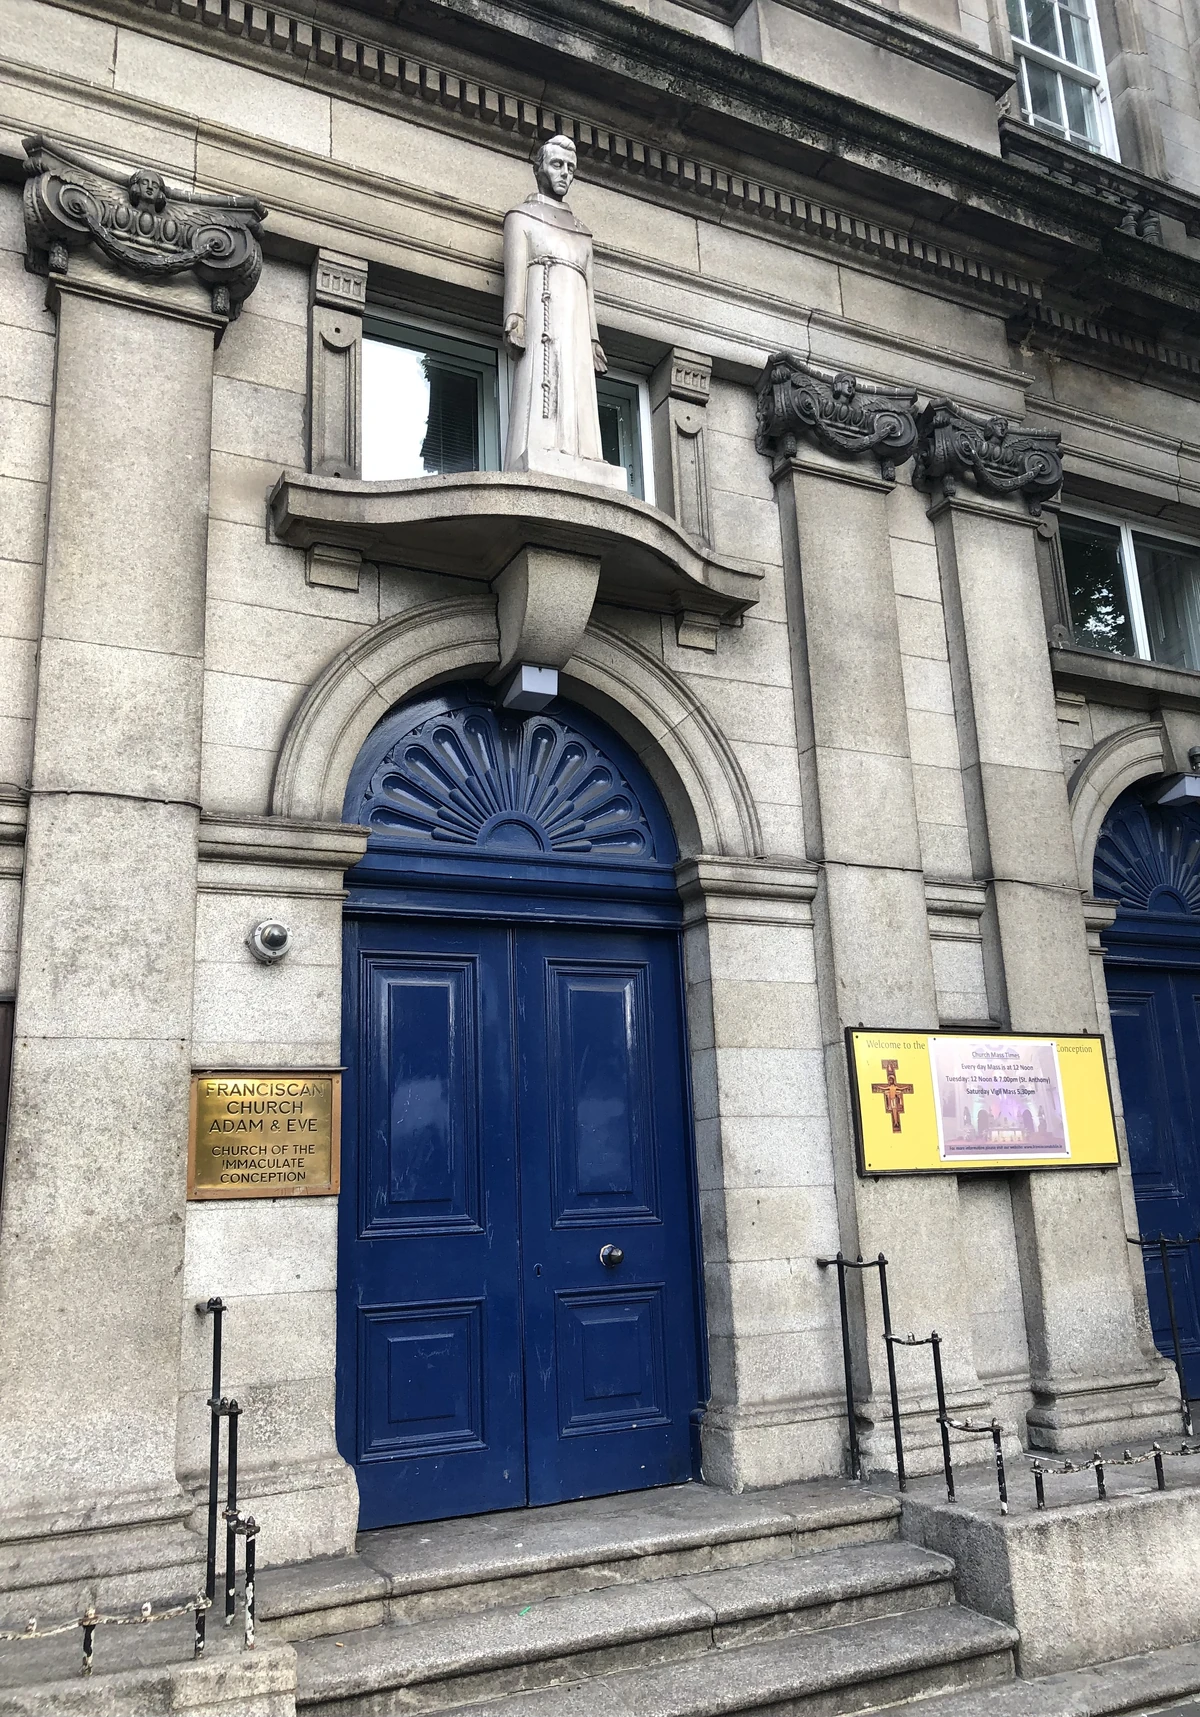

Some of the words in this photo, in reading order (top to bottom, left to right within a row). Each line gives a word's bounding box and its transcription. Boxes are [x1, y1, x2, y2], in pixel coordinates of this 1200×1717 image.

[866, 1039, 901, 1049] Welcome
[913, 1041, 926, 1050] the
[1056, 1044, 1093, 1054] Conception
[977, 1063, 986, 1071] day
[1028, 1076, 1051, 1084] Anthony)
[206, 1083, 325, 1097] FRANCISCAN
[991, 1088, 1002, 1096] Vigil
[226, 1101, 303, 1115] CHURCH
[208, 1119, 263, 1133] ADAM
[270, 1119, 281, 1132] &
[287, 1118, 318, 1132] EVE
[211, 1145, 267, 1156] CHURCH
[271, 1145, 289, 1155] OF
[293, 1144, 315, 1154] THE
[222, 1157, 305, 1169] IMMACULATE
[220, 1171, 306, 1183] CONCEPTION
